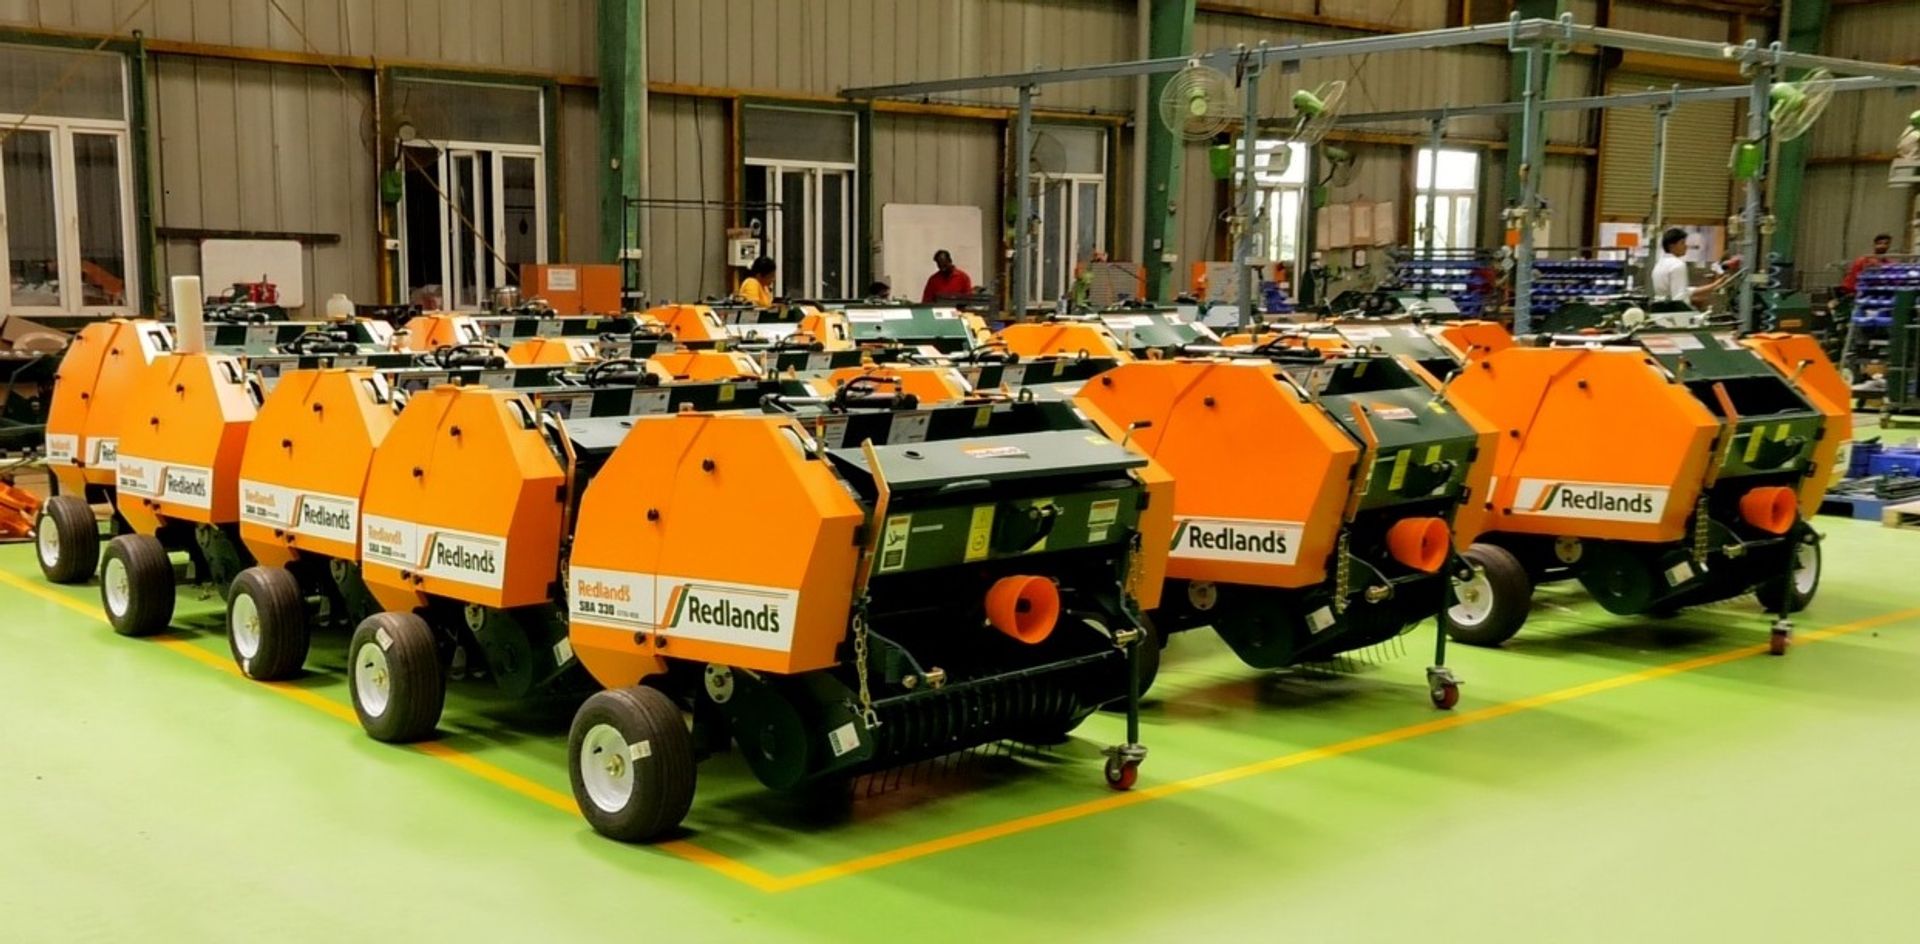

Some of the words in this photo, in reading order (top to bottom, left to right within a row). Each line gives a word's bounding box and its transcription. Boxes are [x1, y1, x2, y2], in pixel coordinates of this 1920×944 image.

[168, 474, 206, 497] Redlands
[1561, 489, 1653, 513] Redlands
[304, 503, 351, 531] Redlands
[1189, 525, 1287, 554] Redlands
[437, 541, 496, 574] Redlands
[577, 578, 632, 603] Redlands
[579, 600, 596, 613] SBA
[597, 602, 615, 616] 330
[688, 596, 780, 633] Redlands
